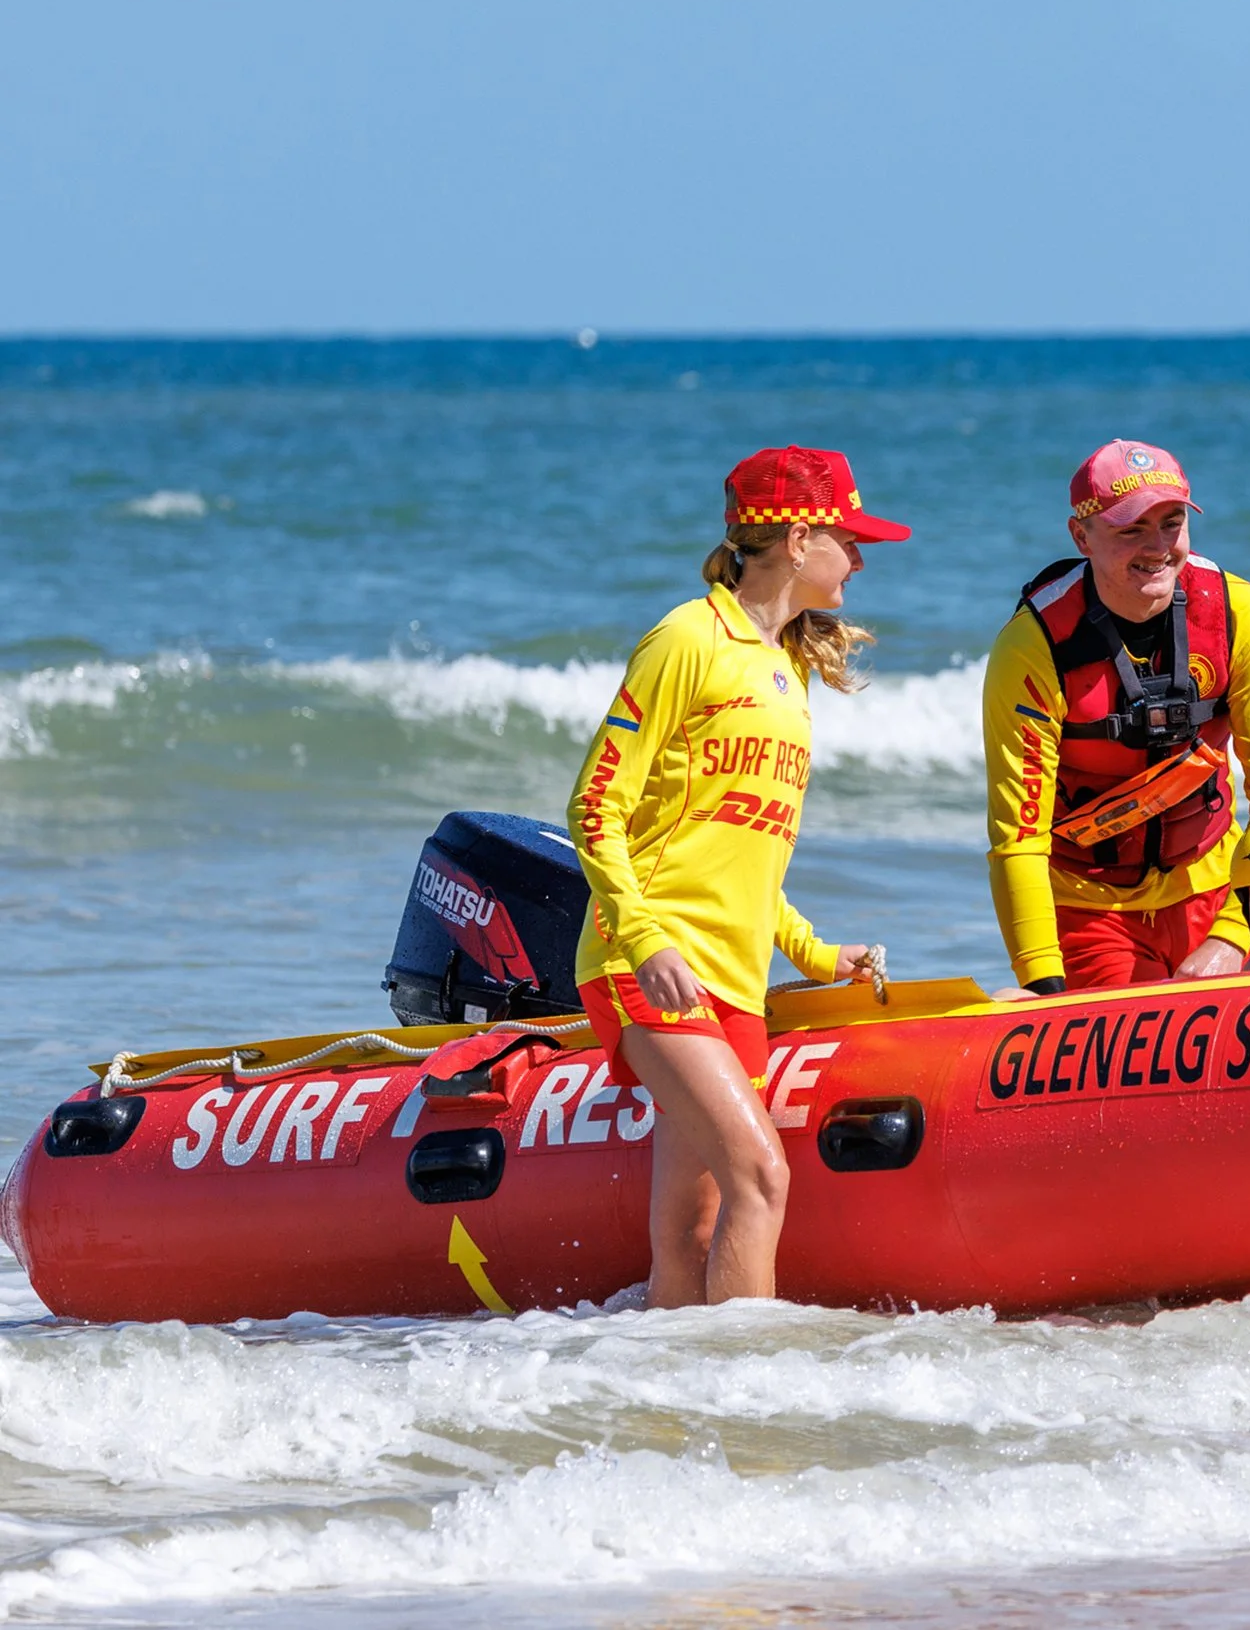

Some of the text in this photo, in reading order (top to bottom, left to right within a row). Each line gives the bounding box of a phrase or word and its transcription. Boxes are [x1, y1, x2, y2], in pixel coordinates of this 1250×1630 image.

[1111, 471, 1184, 497] SURF RESCUE
[581, 736, 622, 857] AMPOL
[701, 736, 773, 777] SURF
[1015, 723, 1043, 843] AMPOL
[416, 861, 496, 927] TOHATSU
[989, 1005, 1220, 1100] GLENELG
[172, 1076, 391, 1170] SURF
